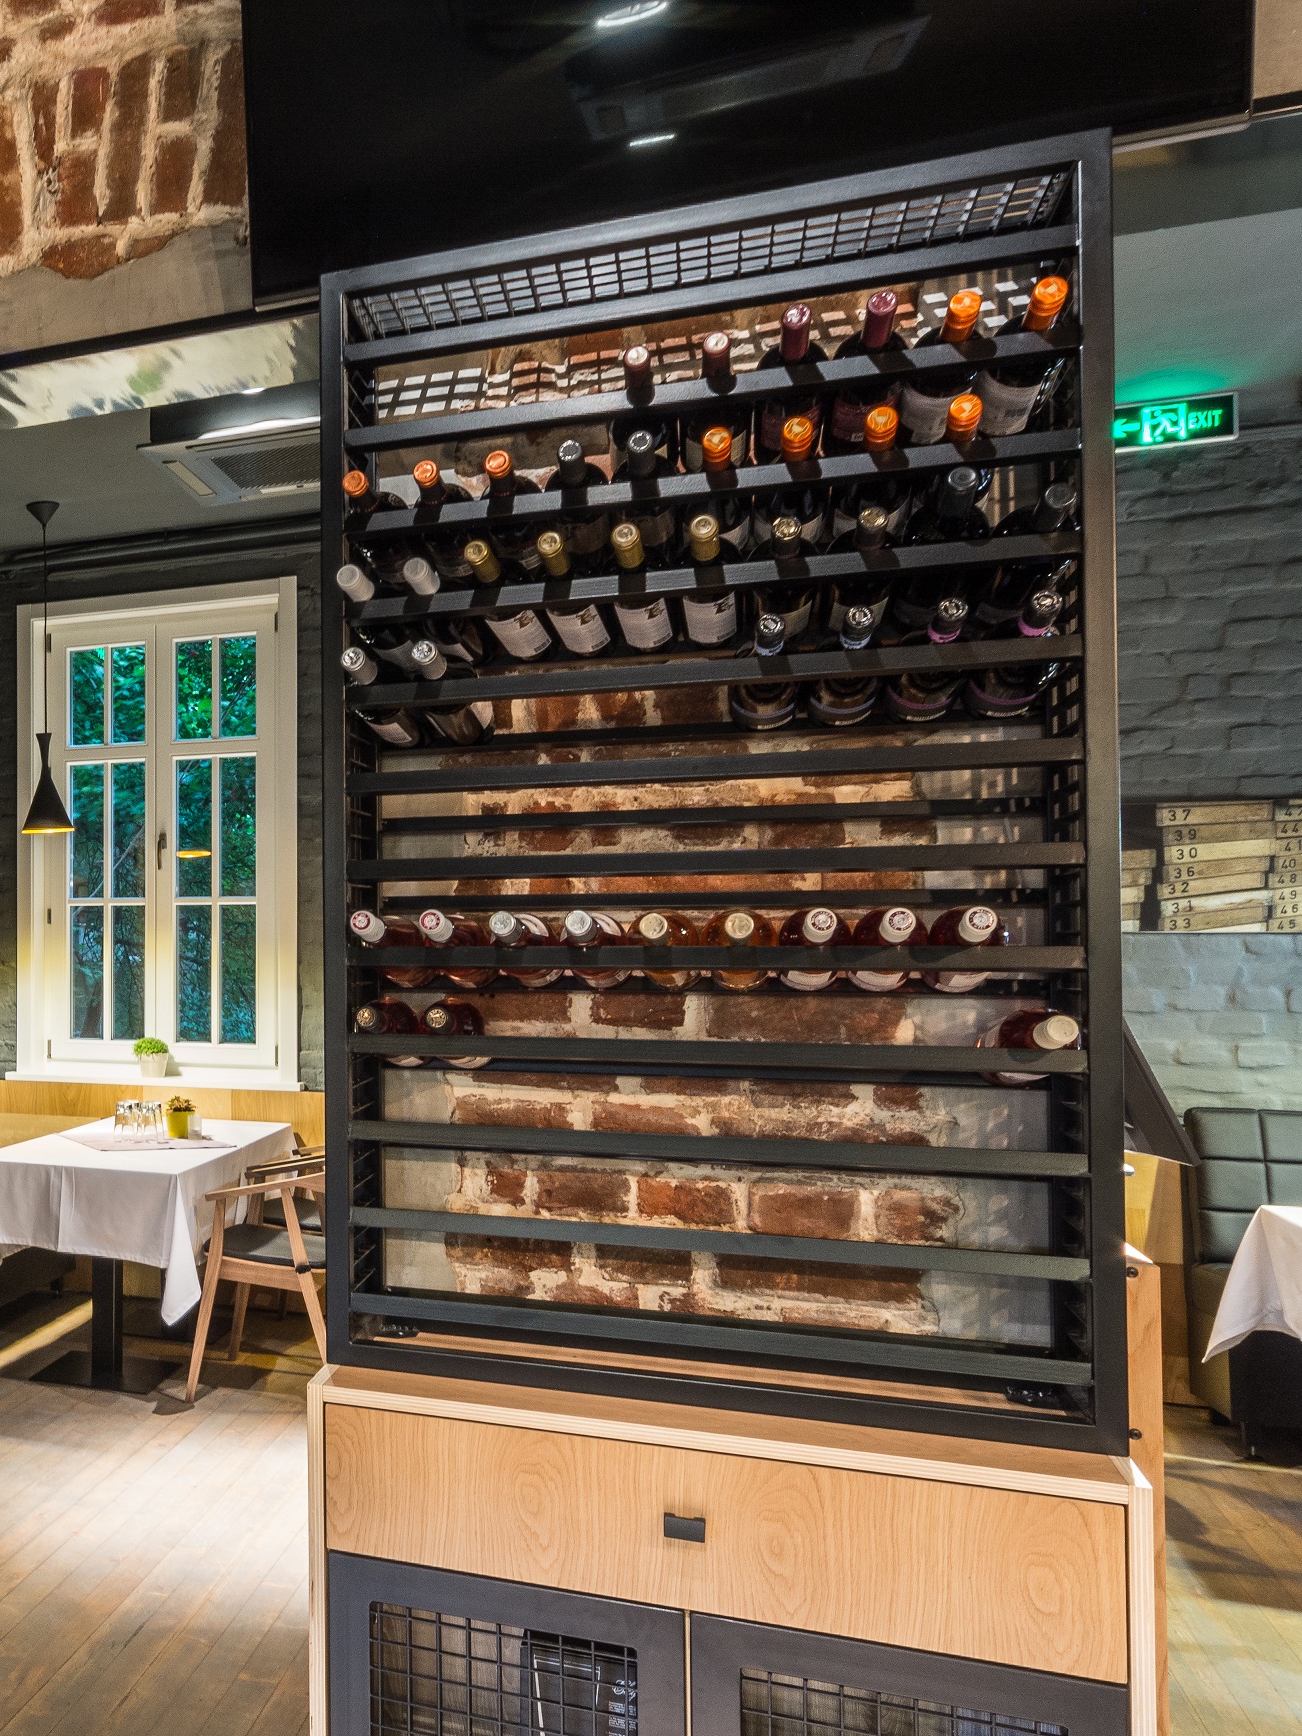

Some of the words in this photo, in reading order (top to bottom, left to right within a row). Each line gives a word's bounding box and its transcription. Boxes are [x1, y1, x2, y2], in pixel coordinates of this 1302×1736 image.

[1188, 409, 1223, 430] EXIT
[1168, 809, 1191, 821] 37
[1281, 822, 1299, 834] 44
[1174, 828, 1197, 842] 39
[1176, 847, 1198, 861] 30
[1281, 858, 1297, 870] 40
[1173, 866, 1195, 879] 36
[1277, 873, 1297, 885] 48
[1168, 881, 1190, 895] 32
[1279, 889, 1297, 901] 49
[1172, 900, 1192, 914] 31
[1280, 904, 1298, 915] 46
[1169, 917, 1191, 931] 33
[1277, 919, 1296, 931] 45
